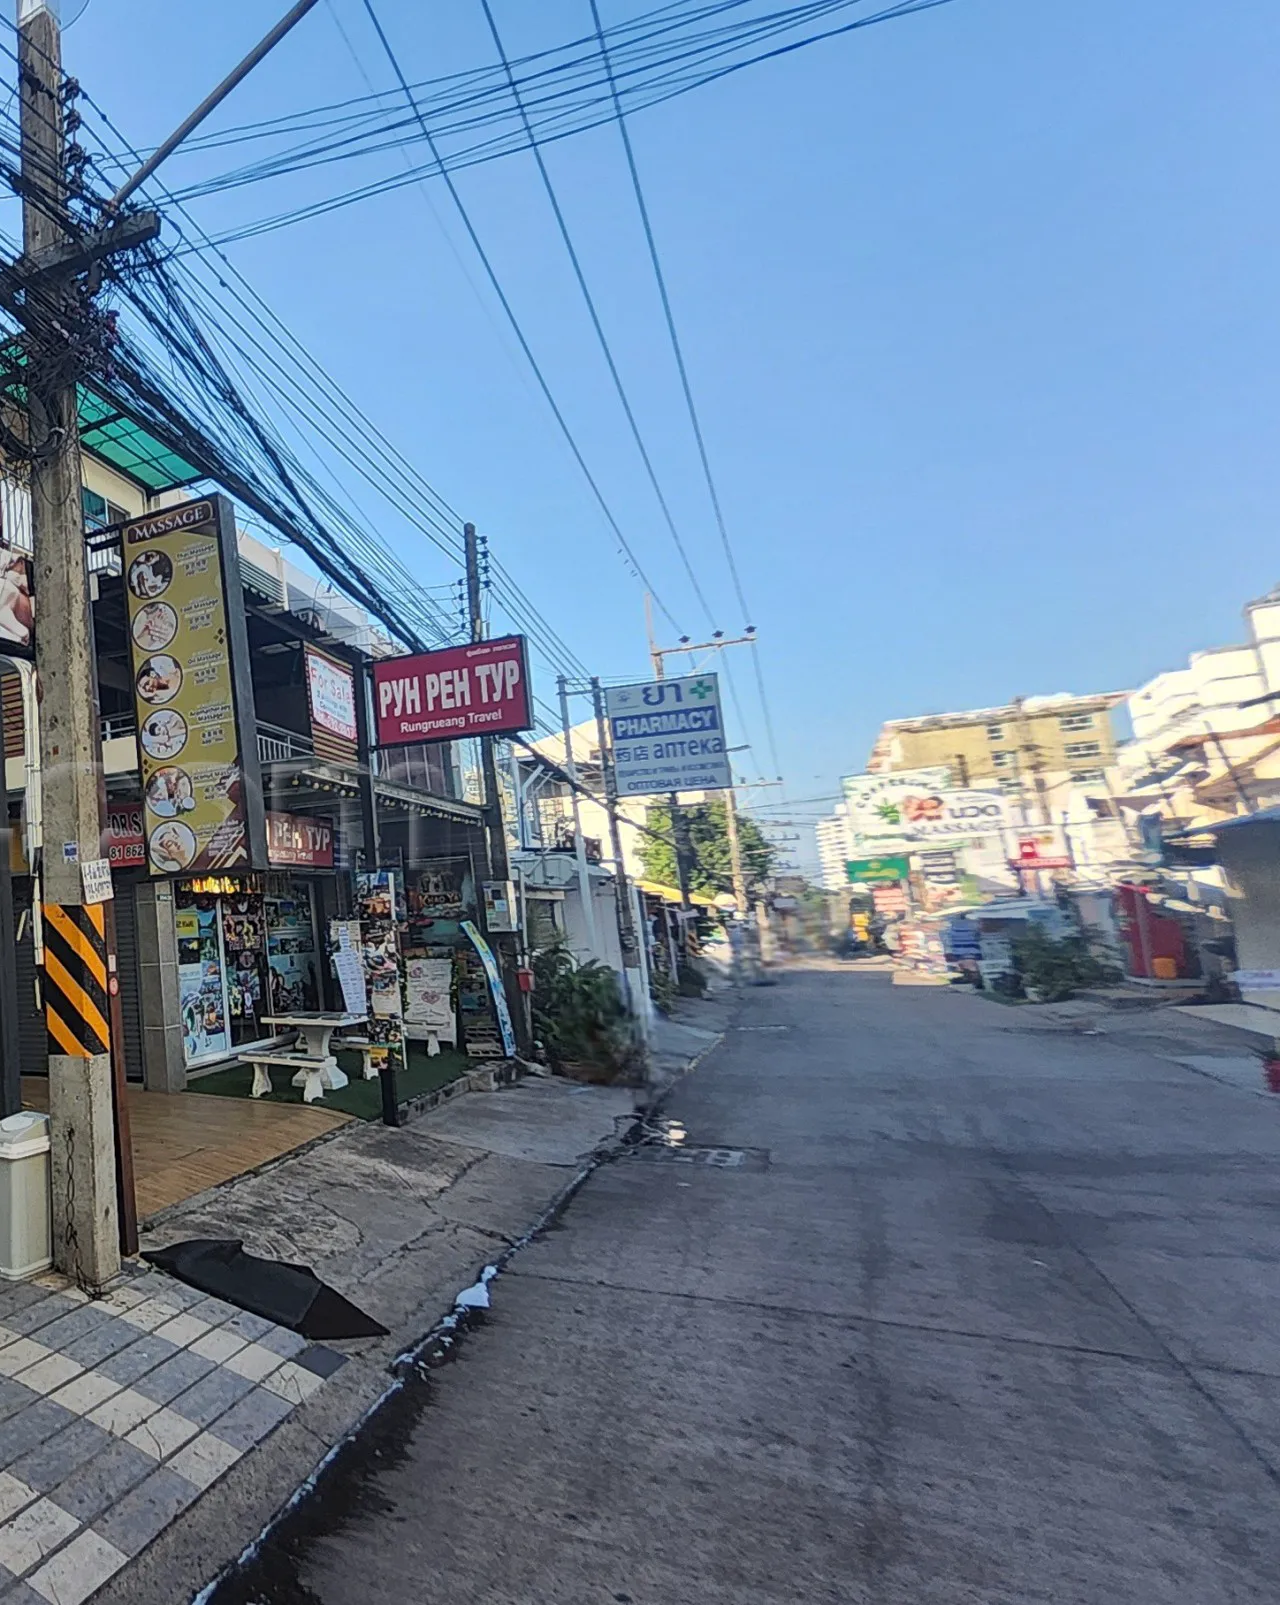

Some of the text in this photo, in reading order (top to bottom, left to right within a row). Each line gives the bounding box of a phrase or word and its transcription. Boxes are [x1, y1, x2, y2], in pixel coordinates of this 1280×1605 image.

[134, 506, 205, 542] MASSAGE
[378, 676, 422, 719] РУН
[425, 668, 471, 712] РЕН
[475, 659, 520, 704] ТУР
[400, 708, 503, 734] Rungrueang Travel
[615, 709, 713, 737] PHARMACY
[652, 737, 723, 760] аптека
